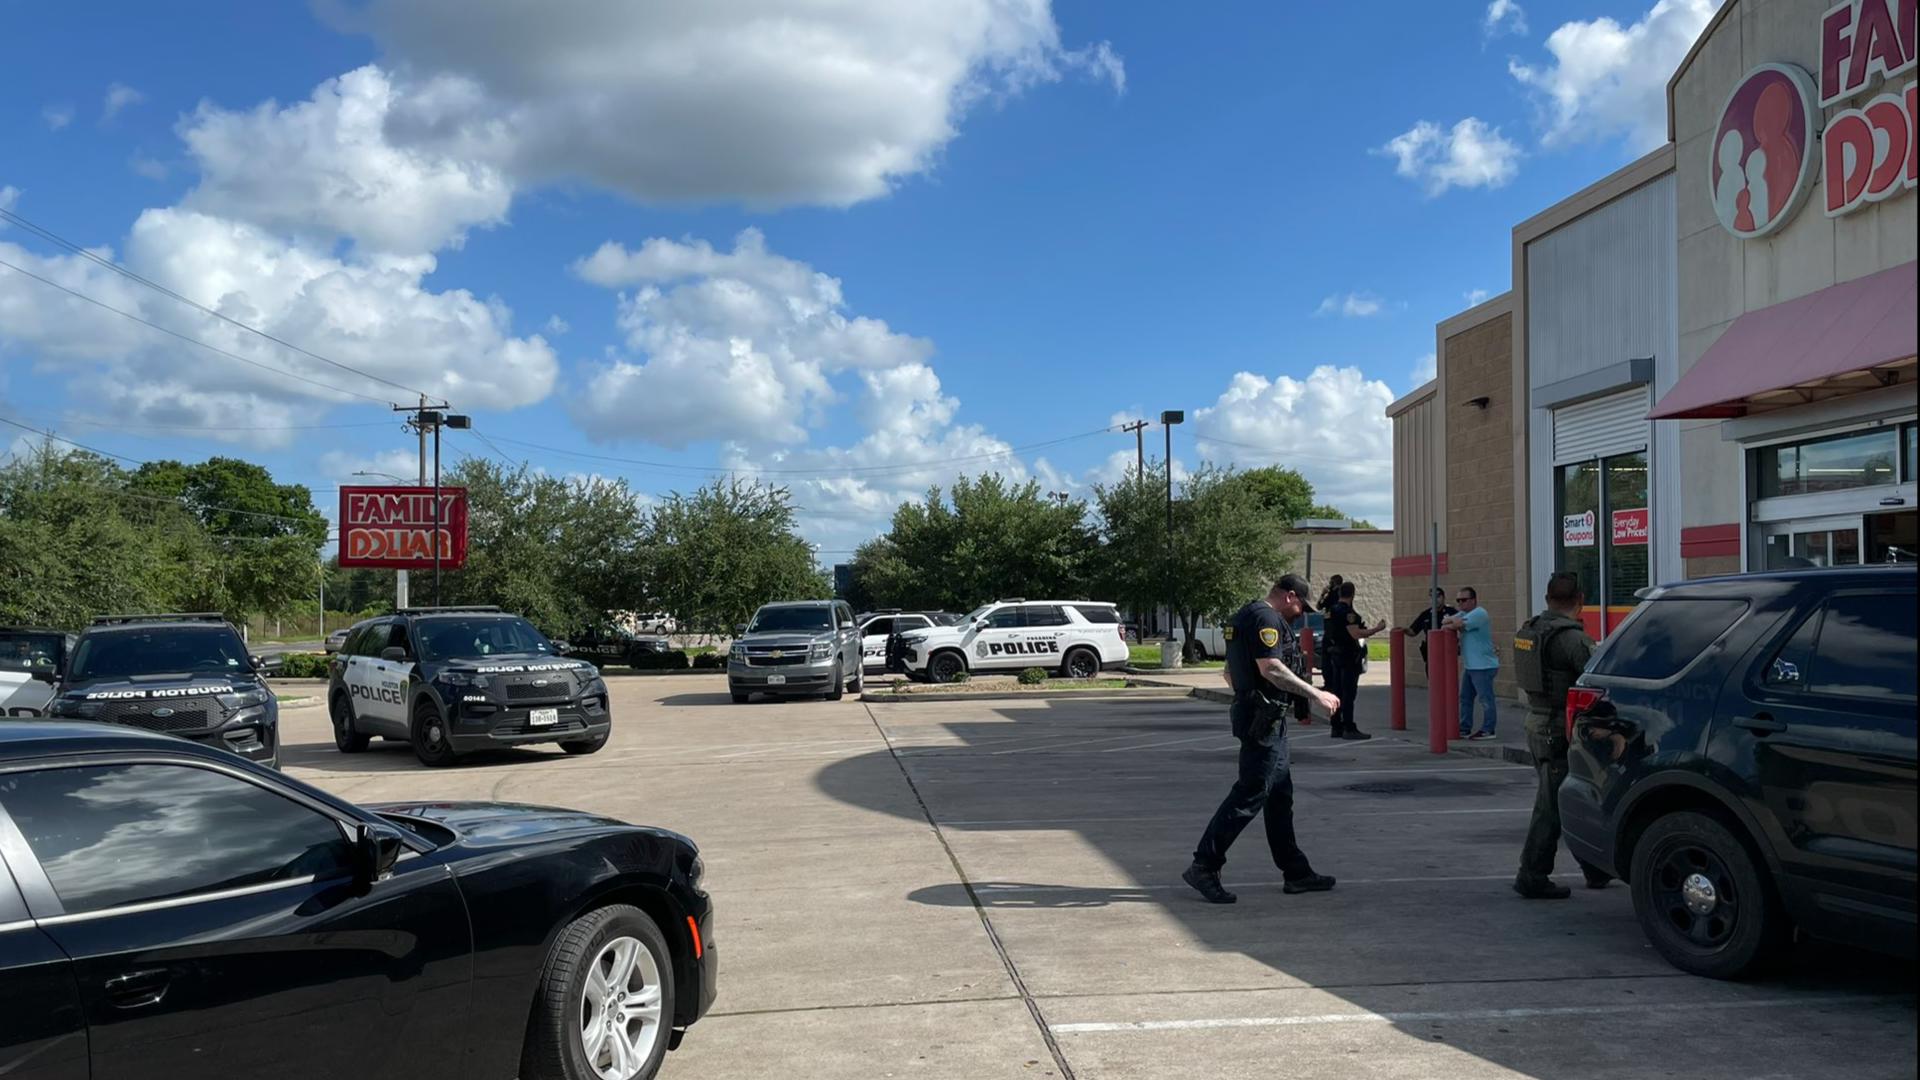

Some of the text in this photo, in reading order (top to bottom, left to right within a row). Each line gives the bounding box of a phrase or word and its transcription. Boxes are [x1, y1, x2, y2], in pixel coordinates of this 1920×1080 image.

[348, 494, 456, 525] FAMILY
[1564, 518, 1585, 528] Smart
[1614, 516, 1640, 529] Everyday
[1564, 530, 1594, 544] Coupons
[1614, 528, 1627, 538] Low
[348, 528, 452, 559] DOLLAR
[570, 645, 617, 654] POLICE
[988, 641, 1060, 656] POLICE
[351, 684, 402, 705] POLICE
